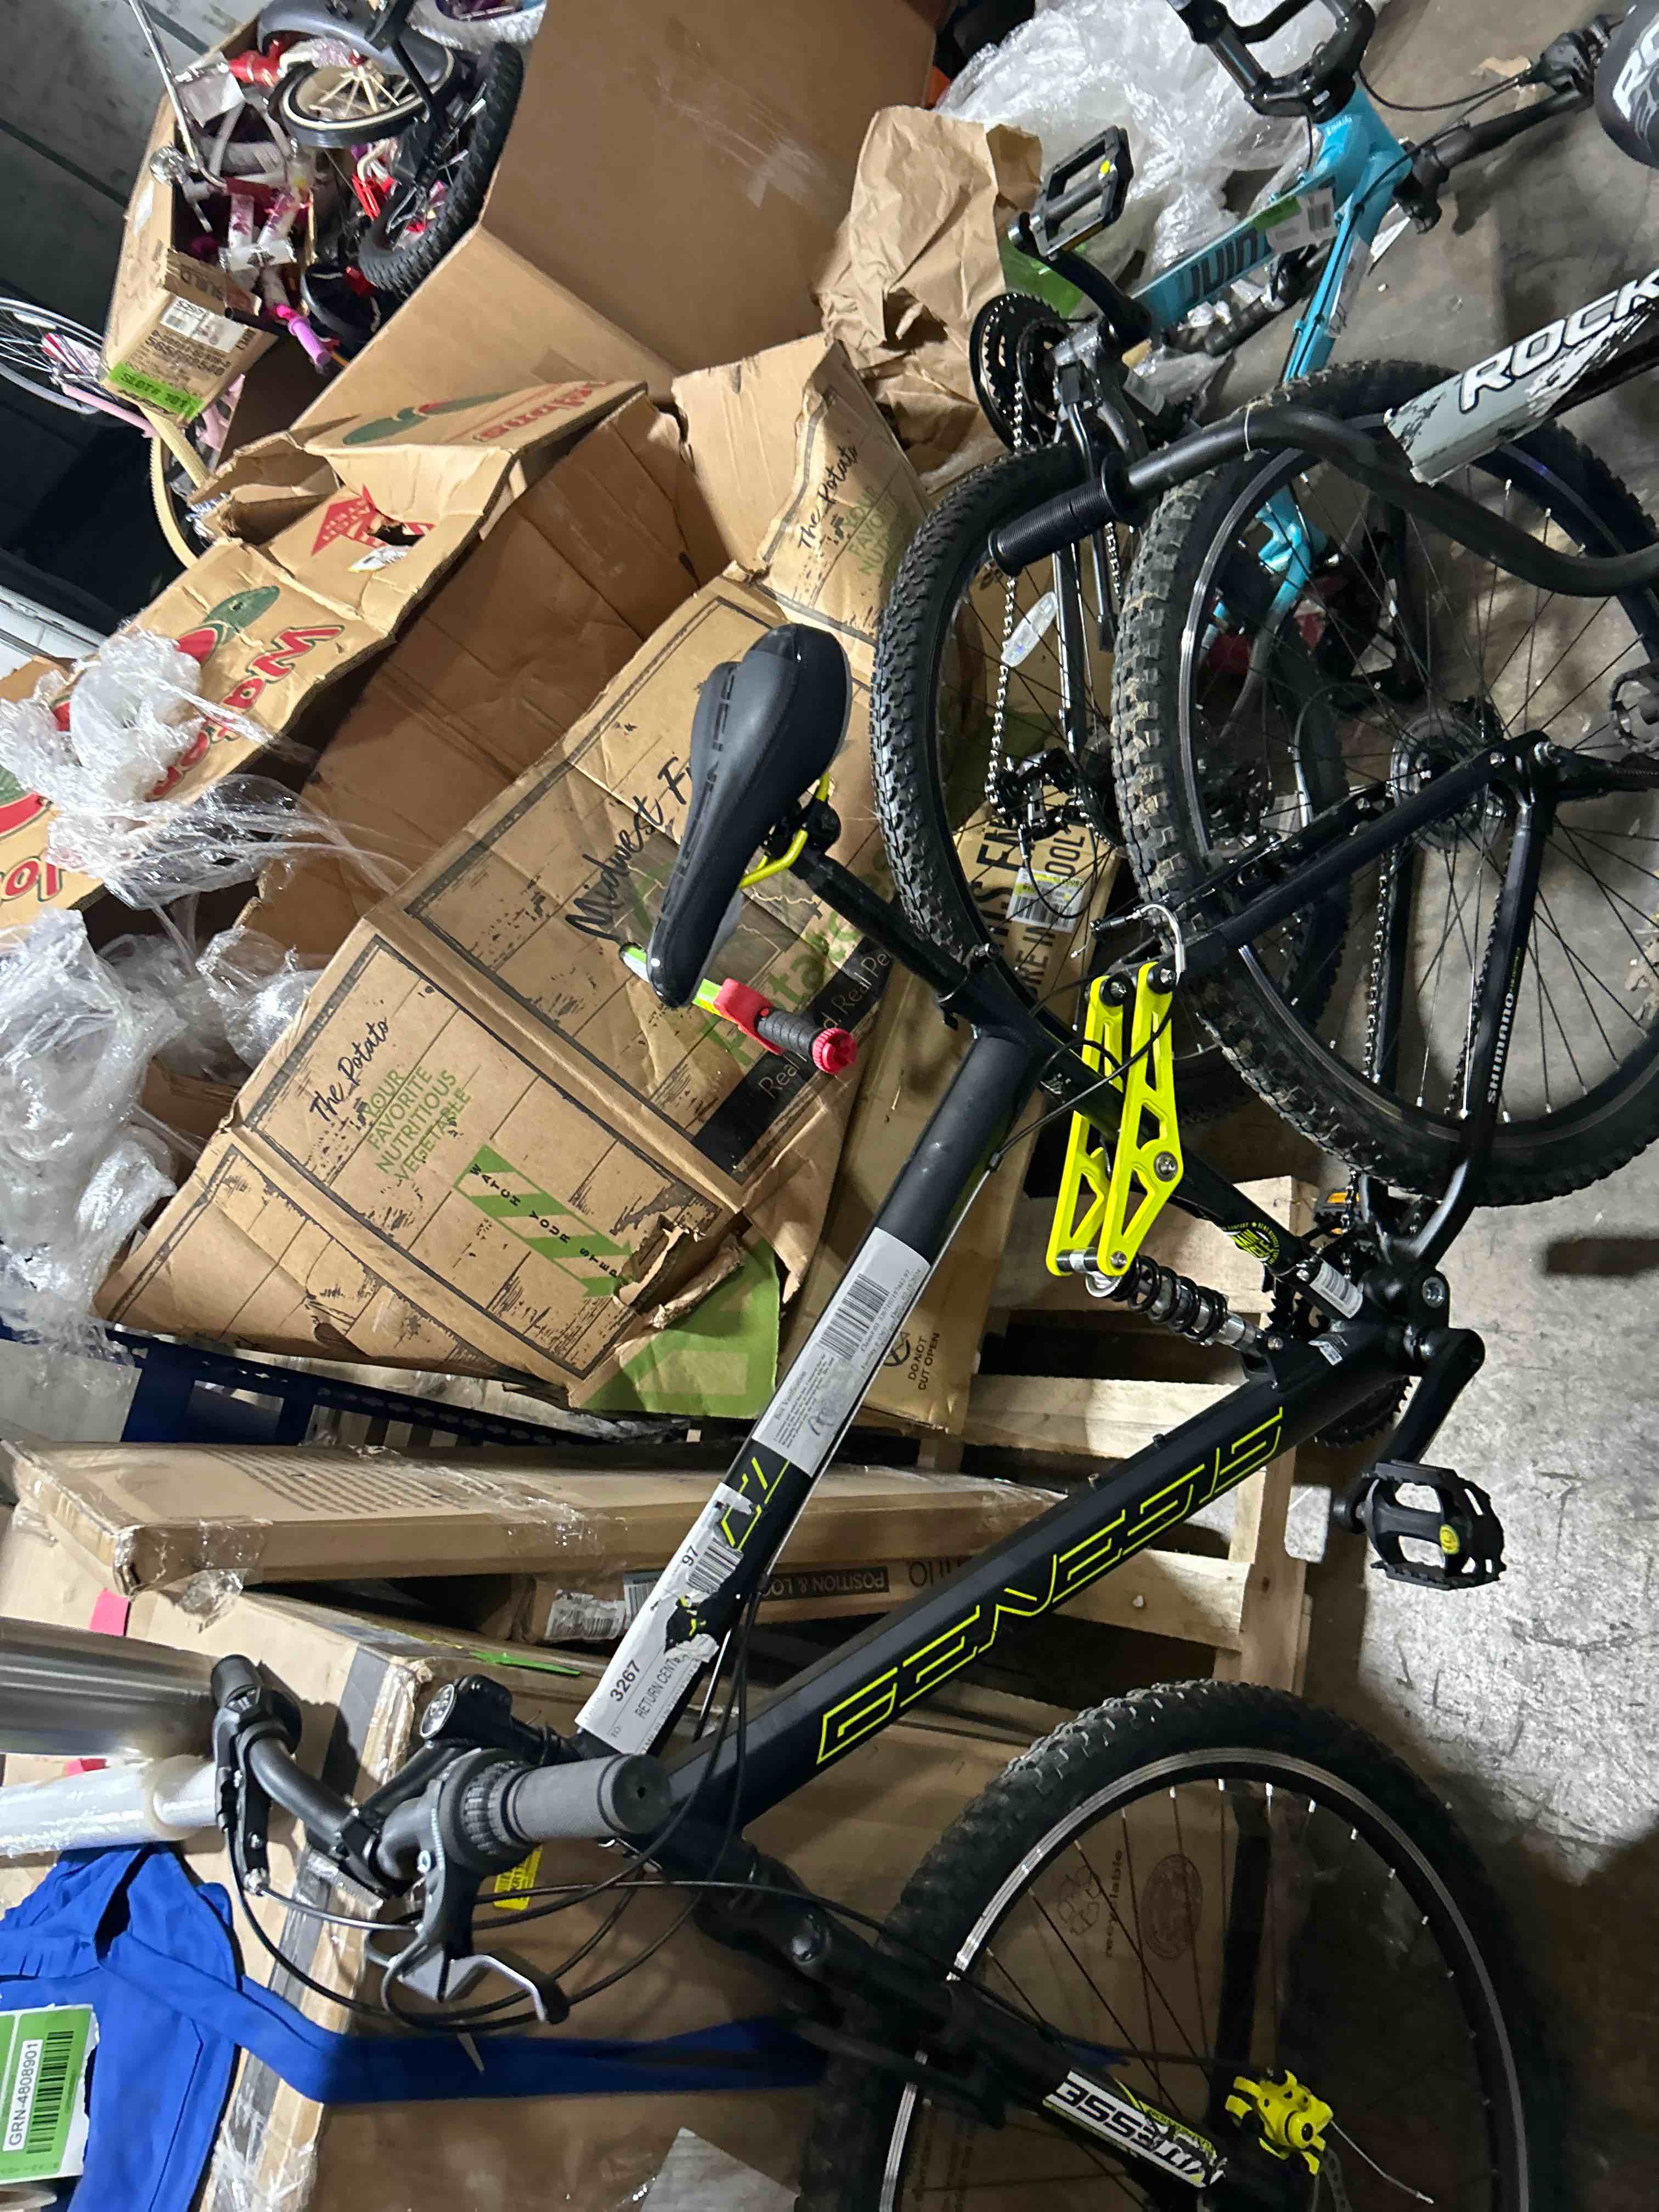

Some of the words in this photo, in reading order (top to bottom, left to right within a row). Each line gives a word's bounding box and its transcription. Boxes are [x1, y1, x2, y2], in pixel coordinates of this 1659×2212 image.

[798, 509, 817, 548] The
[815, 445, 857, 504] Potato
[565, 795, 665, 941] Midwest
[1044, 831, 1084, 878] OOL
[831, 970, 873, 1014] Real
[860, 945, 894, 977] Pe
[309, 1080, 346, 1123] The
[337, 1017, 390, 1096] Potato
[363, 1070, 406, 1125] YOUR
[368, 1065, 433, 1151] FAVORITE
[376, 1070, 456, 1174] NUTRITIOUS
[394, 1089, 471, 1183] VEGETABLE
[470, 1163, 520, 1206] WATCH
[529, 1210, 571, 1244] YOUR
[579, 1247, 619, 1280] STEP
[907, 1362, 919, 1380] DO
[913, 1335, 927, 1362] NOT
[923, 1331, 940, 1366] OPEN
[917, 1368, 930, 1390] CUT
[680, 1544, 701, 1567] 97
[812, 1572, 884, 1591] POSITION
[798, 1578, 806, 1592] &
[608, 1657, 642, 1703] 3267
[634, 1681, 664, 1719] RETURN
[8, 2042, 40, 2147] GRN-4808901
